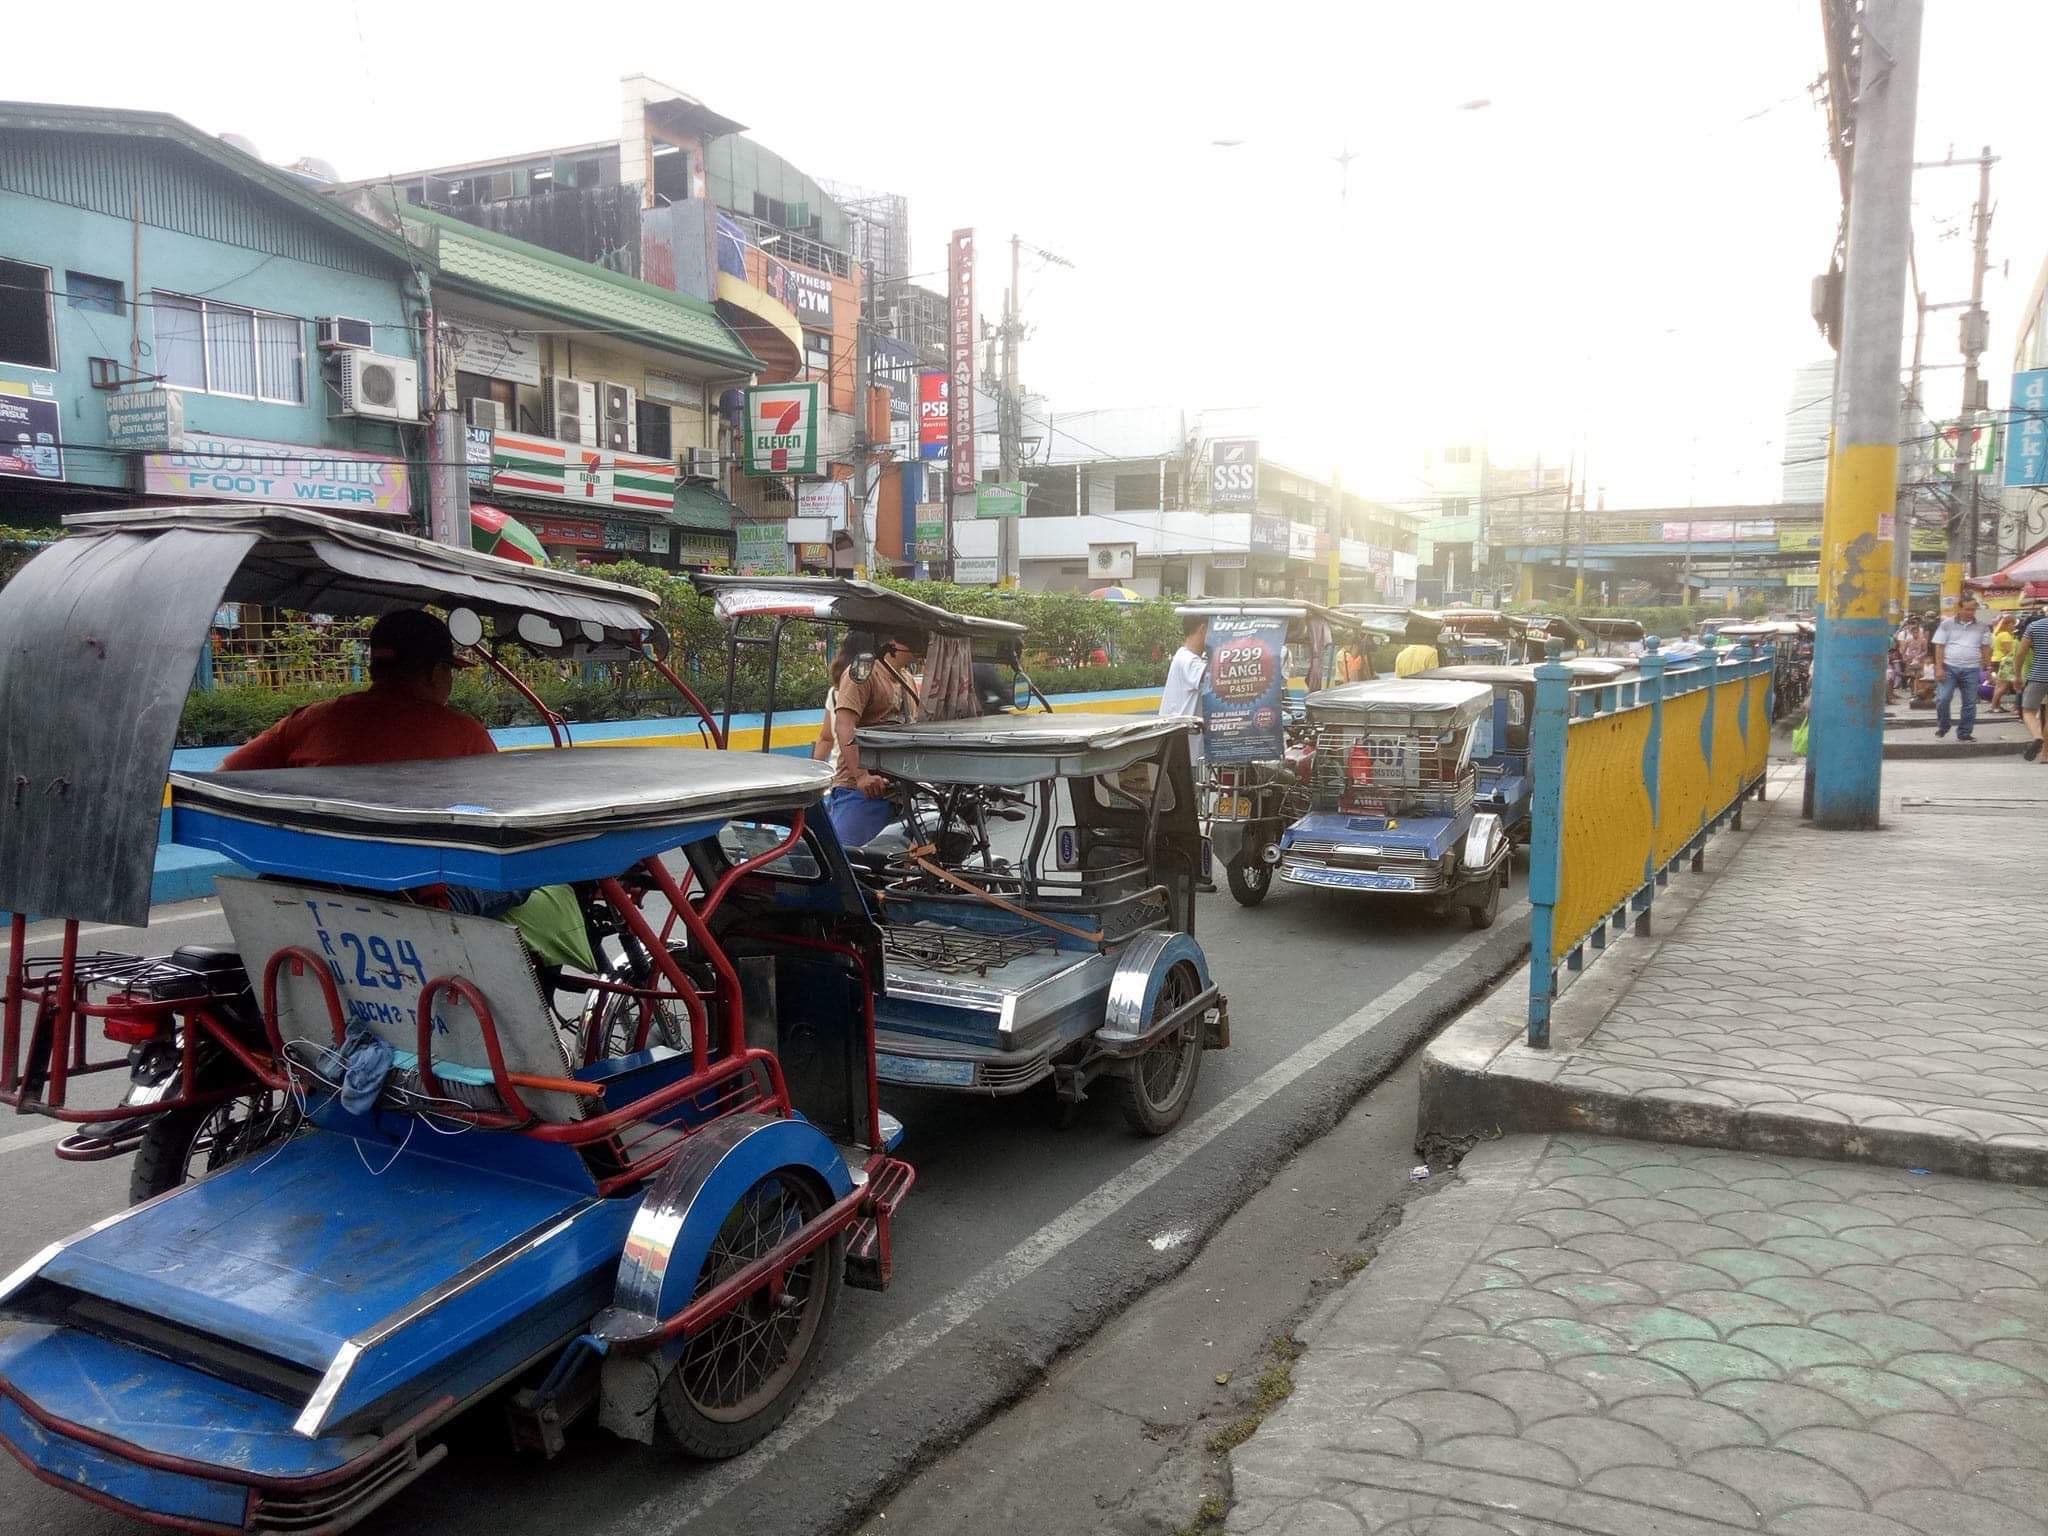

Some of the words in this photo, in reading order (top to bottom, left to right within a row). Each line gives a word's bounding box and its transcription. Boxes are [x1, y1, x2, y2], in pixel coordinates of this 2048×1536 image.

[790, 270, 833, 292] FITNESS
[798, 288, 829, 315] GYM
[106, 390, 167, 412] CONSTANTINO
[121, 424, 145, 435] DENTAL
[145, 422, 166, 433] CLINIC
[171, 439, 292, 476] RUSTY
[189, 473, 275, 495] FOOT
[293, 482, 375, 504] WEAR
[1213, 464, 1254, 491] SSS
[1219, 647, 1263, 664] P299
[1219, 663, 1262, 678] LANG!
[340, 932, 428, 991] 294
[407, 1007, 451, 1037] TA
